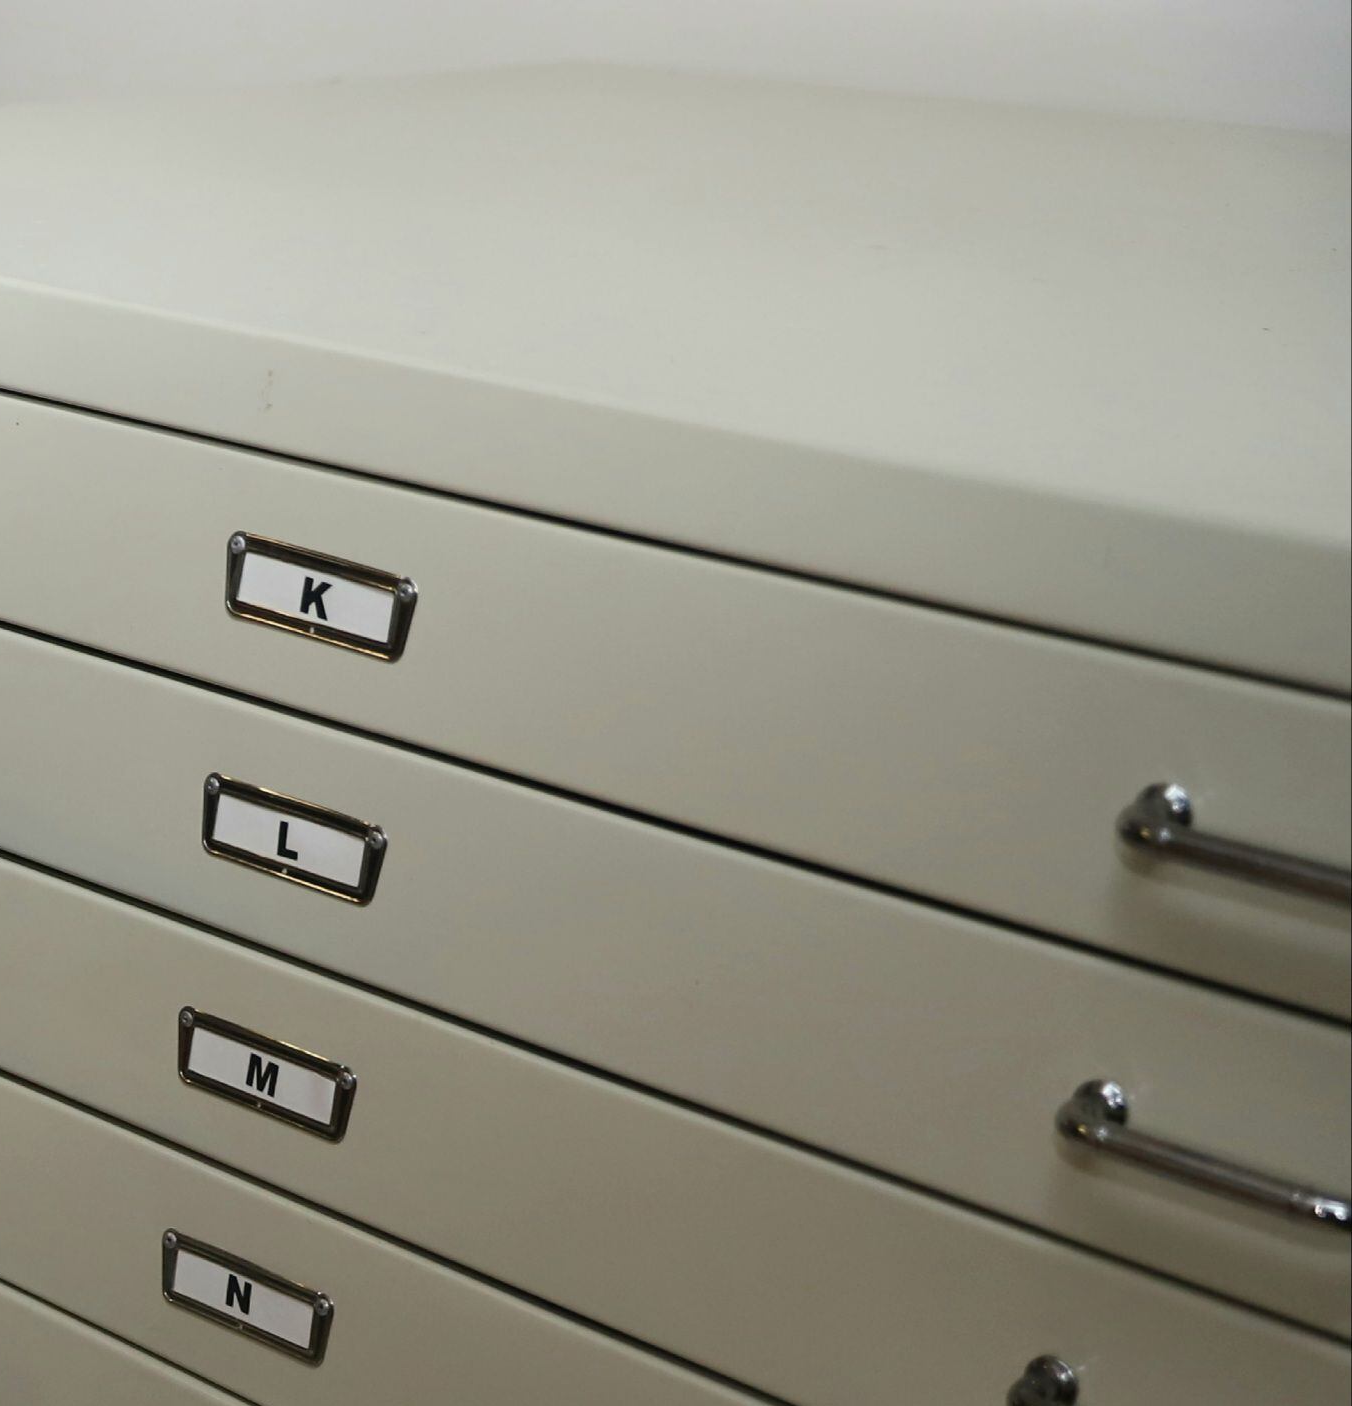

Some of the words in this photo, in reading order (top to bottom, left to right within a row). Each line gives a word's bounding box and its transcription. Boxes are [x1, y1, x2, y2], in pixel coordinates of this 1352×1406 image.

[300, 577, 333, 622] K
[277, 820, 298, 861] L
[246, 1053, 279, 1097] M
[225, 1274, 252, 1315] N
